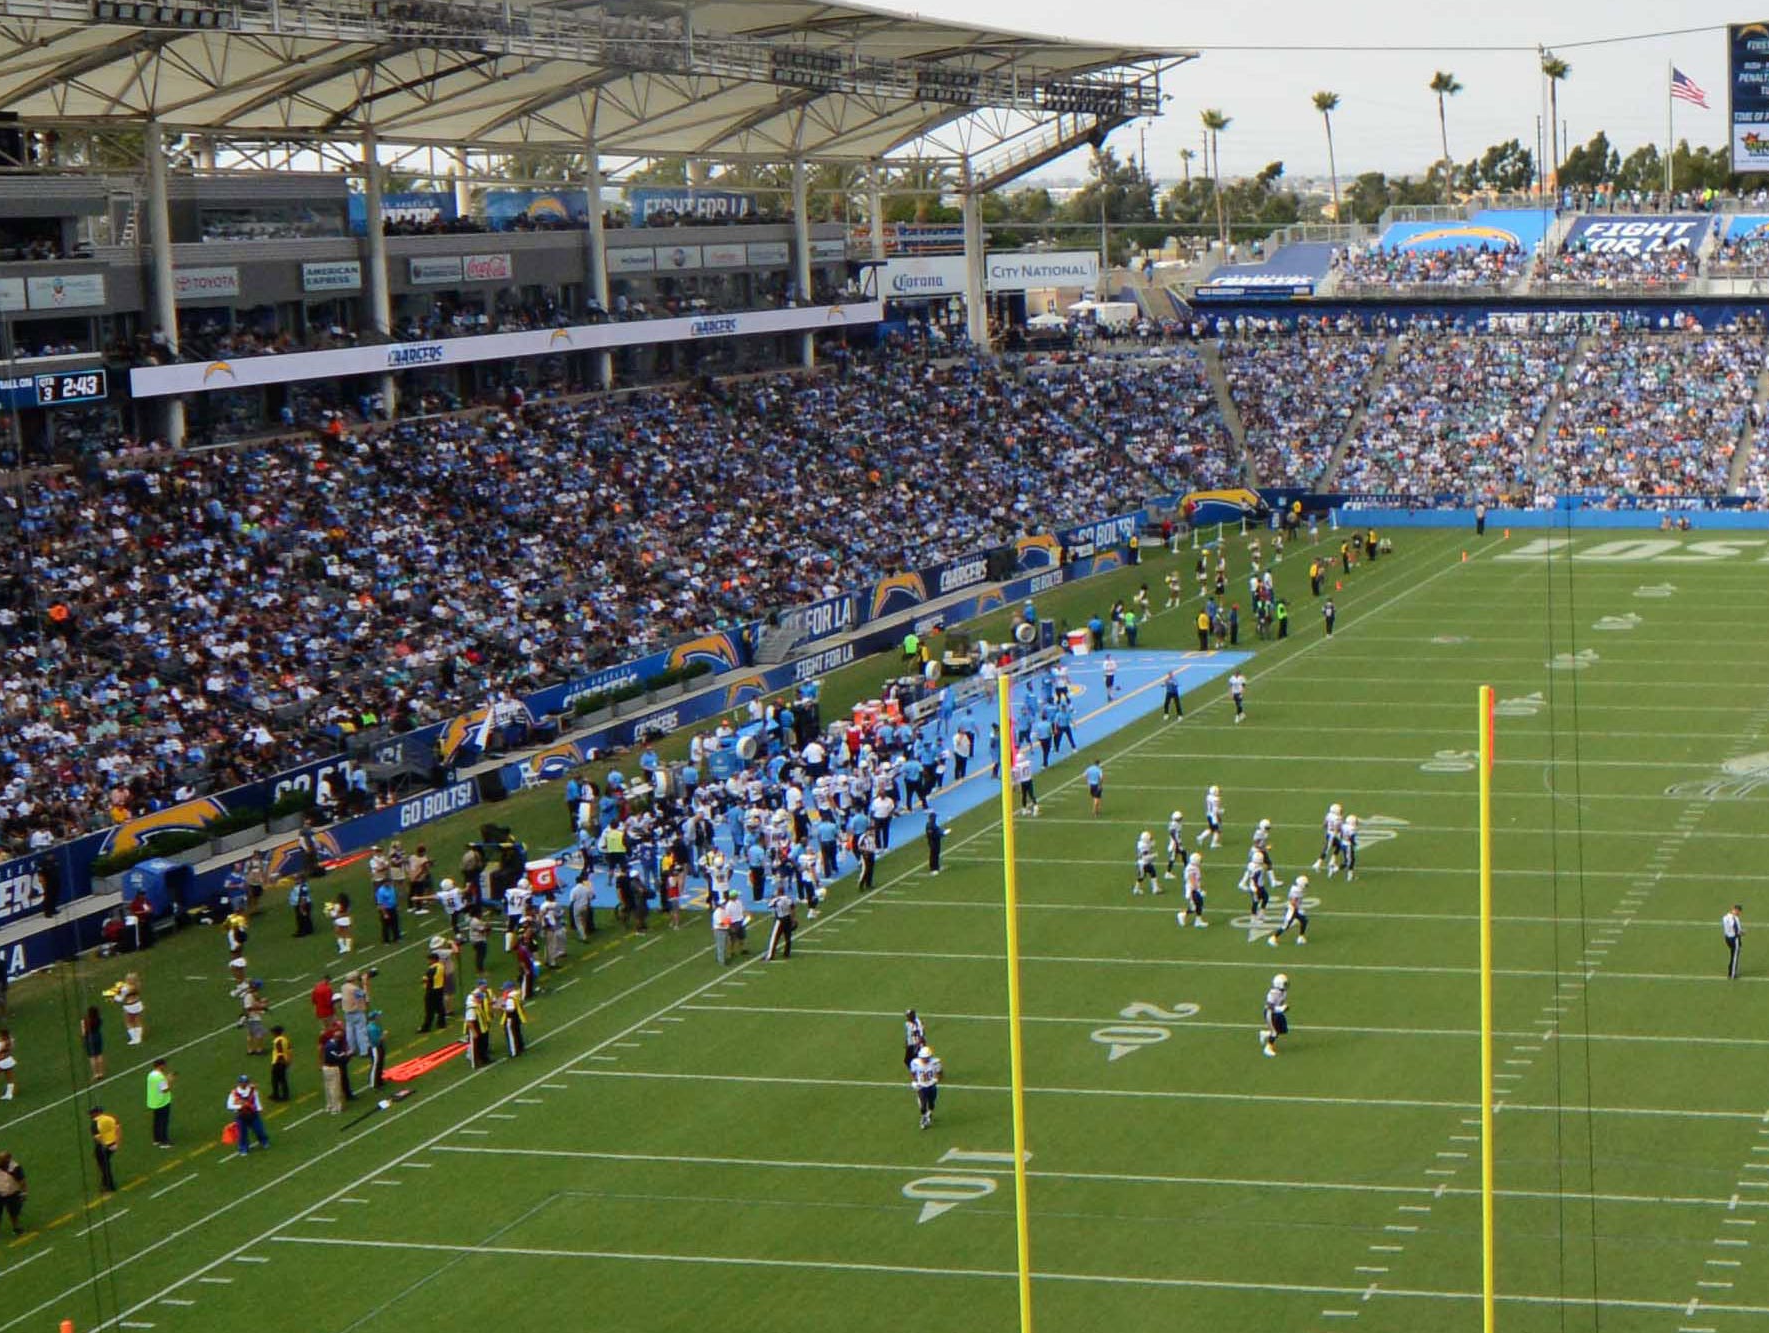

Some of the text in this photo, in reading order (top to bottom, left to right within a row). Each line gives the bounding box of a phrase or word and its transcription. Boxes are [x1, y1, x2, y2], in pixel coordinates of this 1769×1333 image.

[1583, 222, 1697, 237] FIGHT
[305, 267, 359, 277] AMERICAN
[305, 275, 351, 285] EXPRESS
[991, 265, 1087, 279] CITY NATIONAL
[192, 277, 237, 290] TOYOTA
[892, 274, 943, 292] Corona
[43, 376, 98, 401] 3 2:43
[1494, 539, 1768, 563] LOS
[940, 558, 989, 593] CHARGERS
[401, 782, 473, 827] GO BOLTS!
[537, 872, 552, 885] G
[1090, 1001, 1200, 1044] 20
[901, 1147, 1033, 1203] 10
